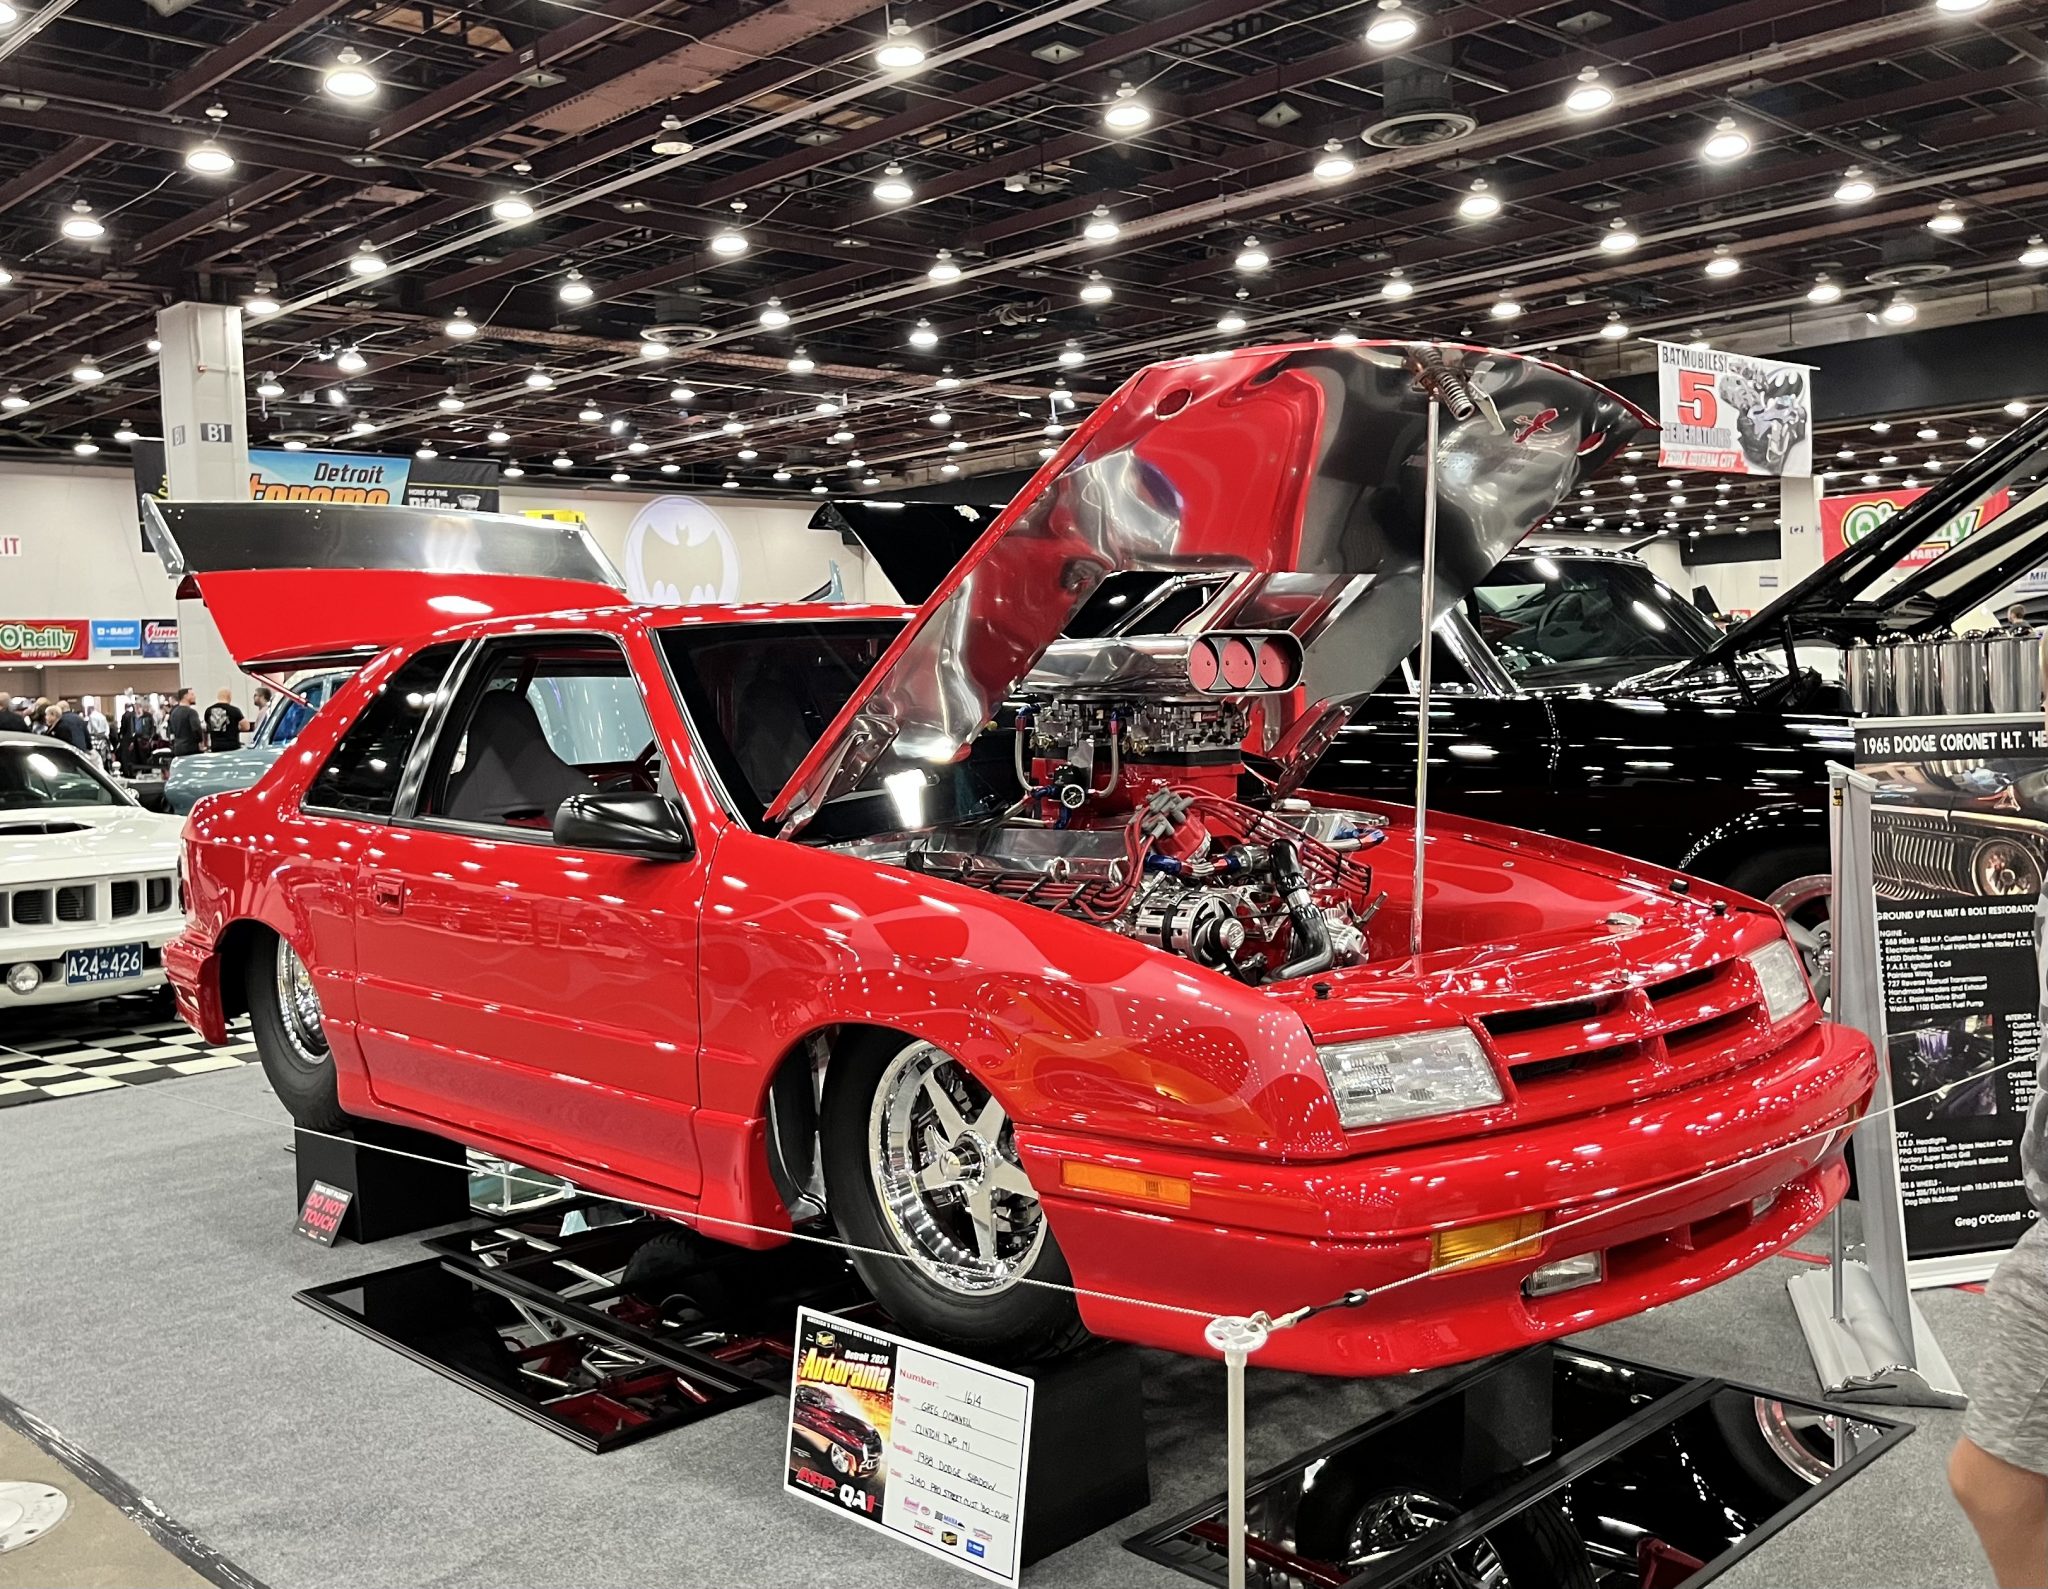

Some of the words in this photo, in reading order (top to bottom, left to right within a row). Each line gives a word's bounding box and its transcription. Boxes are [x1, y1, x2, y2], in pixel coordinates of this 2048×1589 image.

[1662, 346, 1728, 374] BATMOBILES!
[1677, 369, 1718, 429] 5
[208, 424, 225, 442] B1
[314, 463, 384, 484] Detroit
[0, 537, 19, 554] IT
[1, 625, 74, 651] O'Reilly
[146, 622, 178, 641] SUMM
[1863, 737, 1891, 755] 1965
[1894, 734, 1937, 753] DODGE
[1940, 732, 1997, 751] CORONET
[2001, 731, 2025, 749] H.T.
[2029, 730, 2048, 748] 'HE
[1877, 911, 1914, 921] GROUND
[1915, 910, 1925, 919] UP
[1926, 910, 1943, 919] FULL
[1944, 908, 1959, 917] NUT
[1960, 908, 1966, 916] &
[1968, 907, 1987, 916] BOLT
[1954, 943, 1981, 951] Injection
[70, 955, 99, 977] A24
[110, 952, 140, 972] 426
[1939, 960, 1952, 968] Coil
[86, 972, 124, 981] ONTARIO
[1964, 983, 1987, 991] Exhaust
[1916, 1179, 1938, 1188] WHEELS
[307, 1192, 324, 1208] DO
[323, 1198, 347, 1217] NOT
[303, 1207, 337, 1232] TOUCH
[1955, 1218, 1978, 1228] Greg
[1979, 1212, 2021, 1225] O'Connell
[844, 1350, 869, 1362] Detroit
[871, 1354, 890, 1365] 2024
[801, 1348, 892, 1392] Autorama
[900, 1369, 940, 1389] Number:
[964, 1390, 982, 1406] 1614
[922, 1402, 938, 1416] GREG
[796, 1467, 837, 1491] ARP
[840, 1484, 876, 1513] QA1
